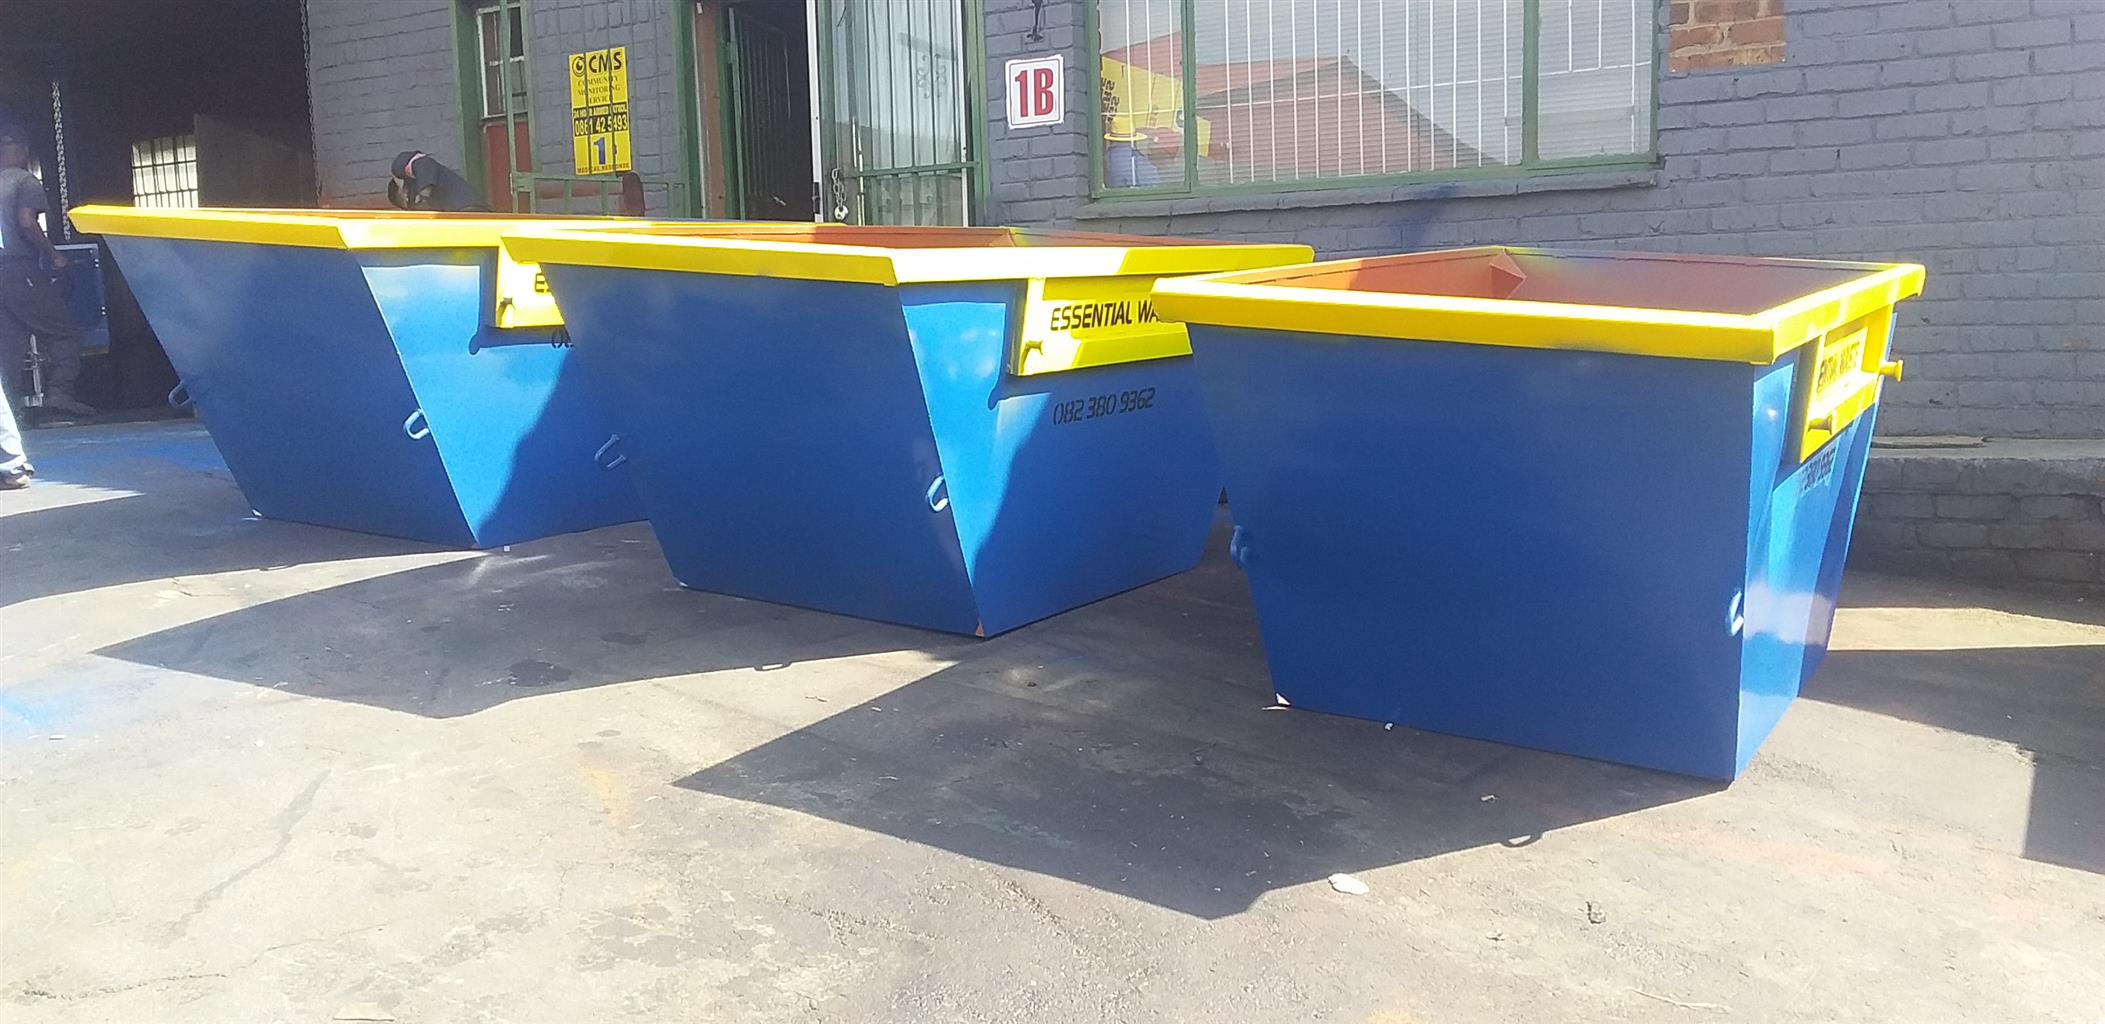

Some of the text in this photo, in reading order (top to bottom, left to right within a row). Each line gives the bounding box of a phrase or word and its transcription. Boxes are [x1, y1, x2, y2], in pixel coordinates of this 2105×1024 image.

[588, 51, 622, 73] CMS
[578, 84, 621, 96] MNITORNG
[1014, 67, 1054, 118] 1B
[575, 117, 593, 136] 0861
[595, 116, 606, 133] 42
[1050, 300, 1133, 332] ESSENTIAL
[1053, 387, 1156, 425] 082 380 9362
